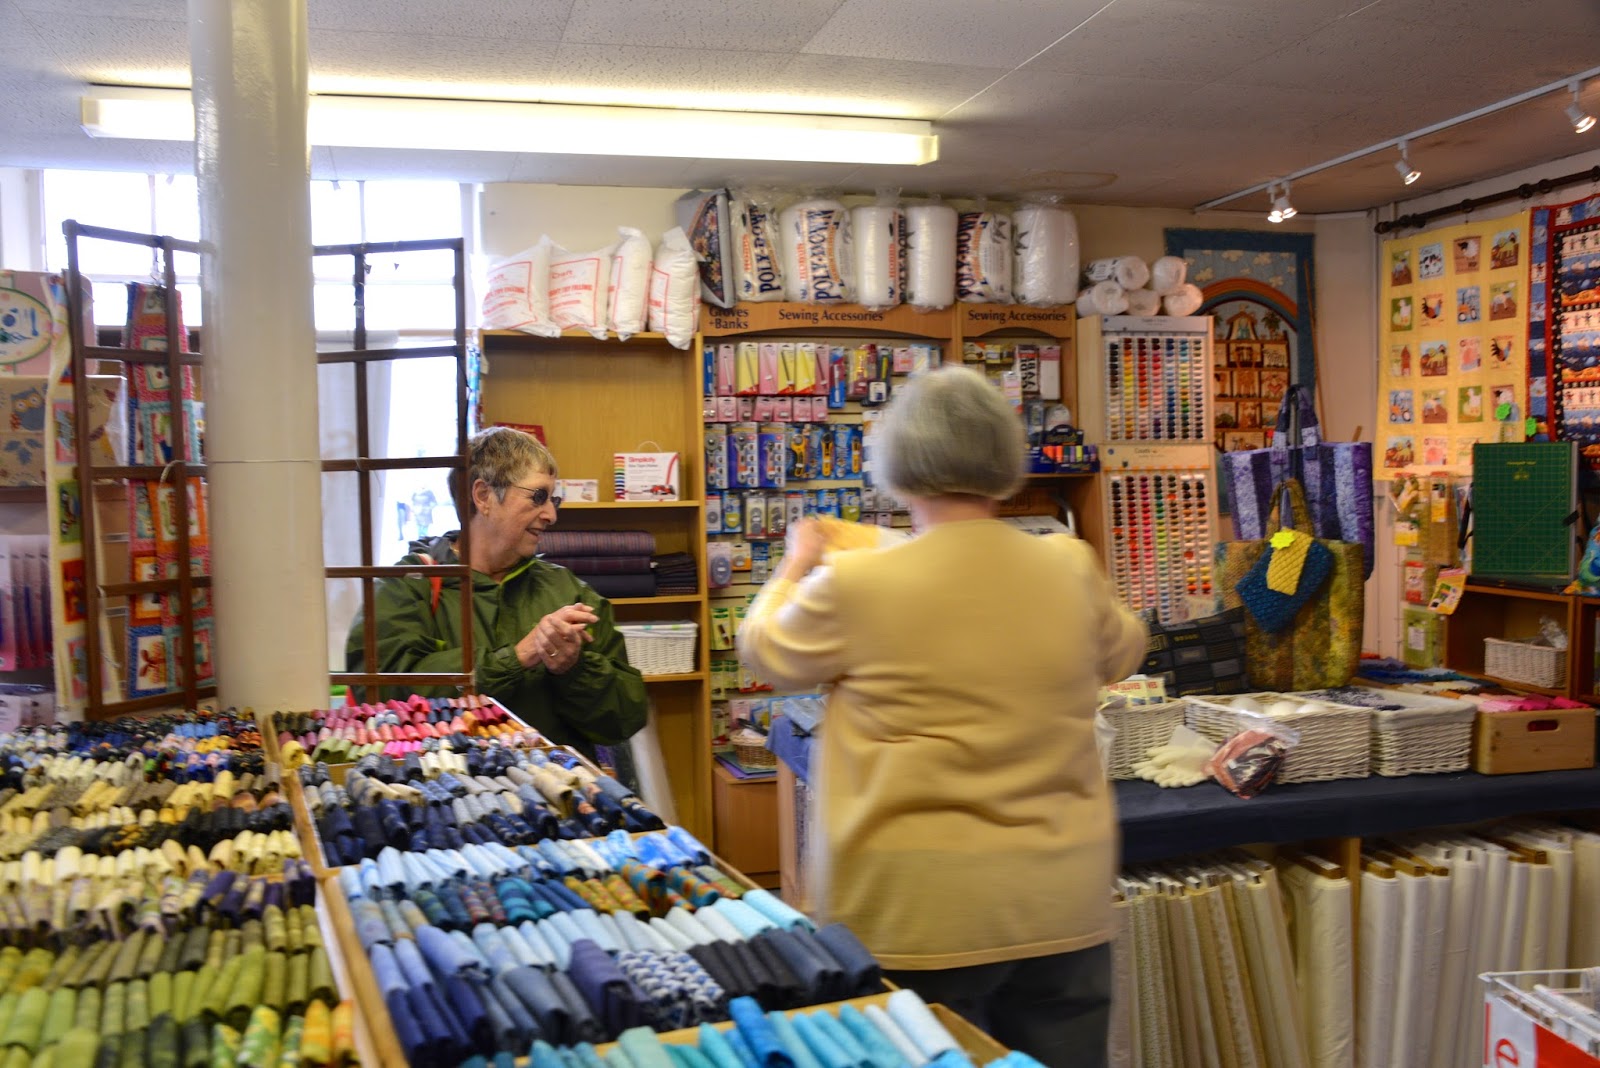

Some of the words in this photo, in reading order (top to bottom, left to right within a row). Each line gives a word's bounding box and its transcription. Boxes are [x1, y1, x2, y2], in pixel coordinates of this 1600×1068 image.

[778, 308, 819, 324] Sewing
[821, 309, 883, 321] Accessories
[968, 309, 1006, 324] Sewing
[1008, 310, 1067, 321] Accessories
